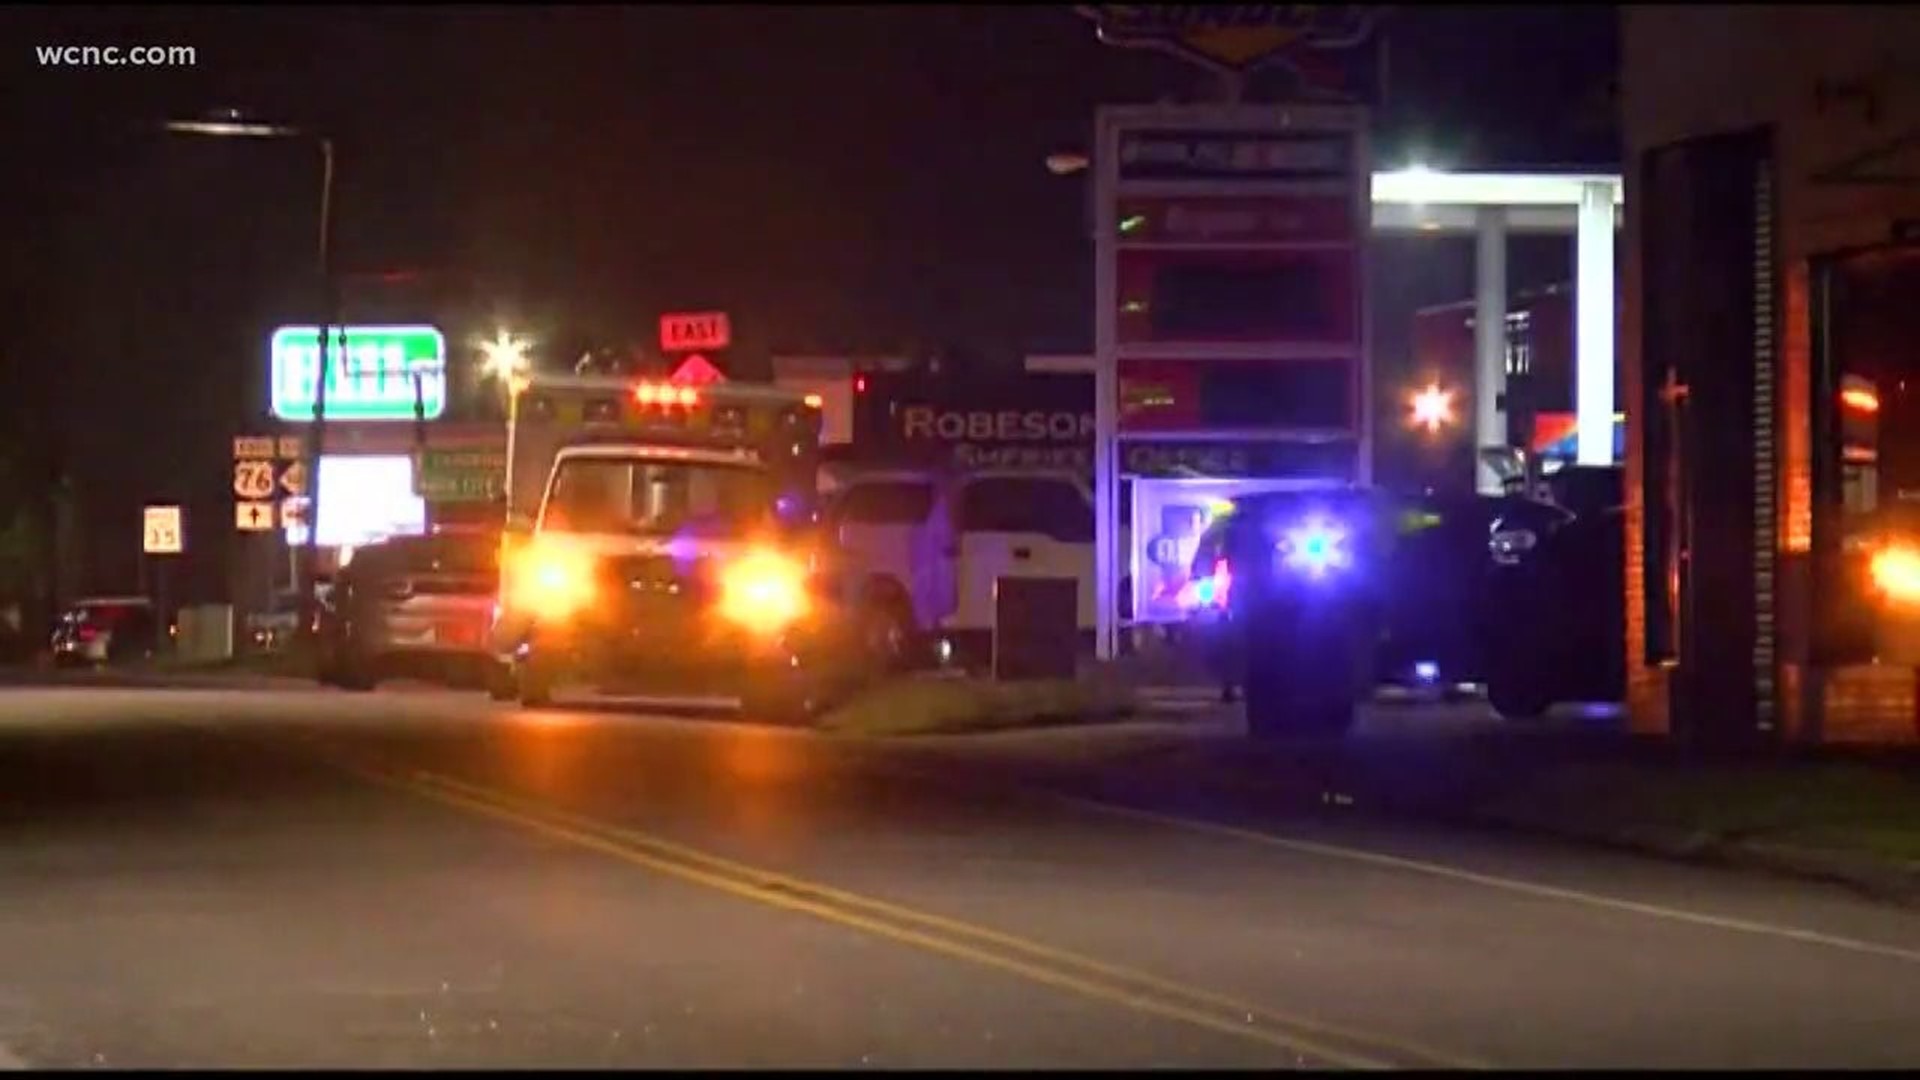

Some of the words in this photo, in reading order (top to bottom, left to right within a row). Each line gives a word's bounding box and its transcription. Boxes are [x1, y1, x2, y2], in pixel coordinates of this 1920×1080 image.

[670, 320, 719, 340] EAST
[904, 406, 1095, 439] ROBESON
[240, 467, 270, 491] 76
